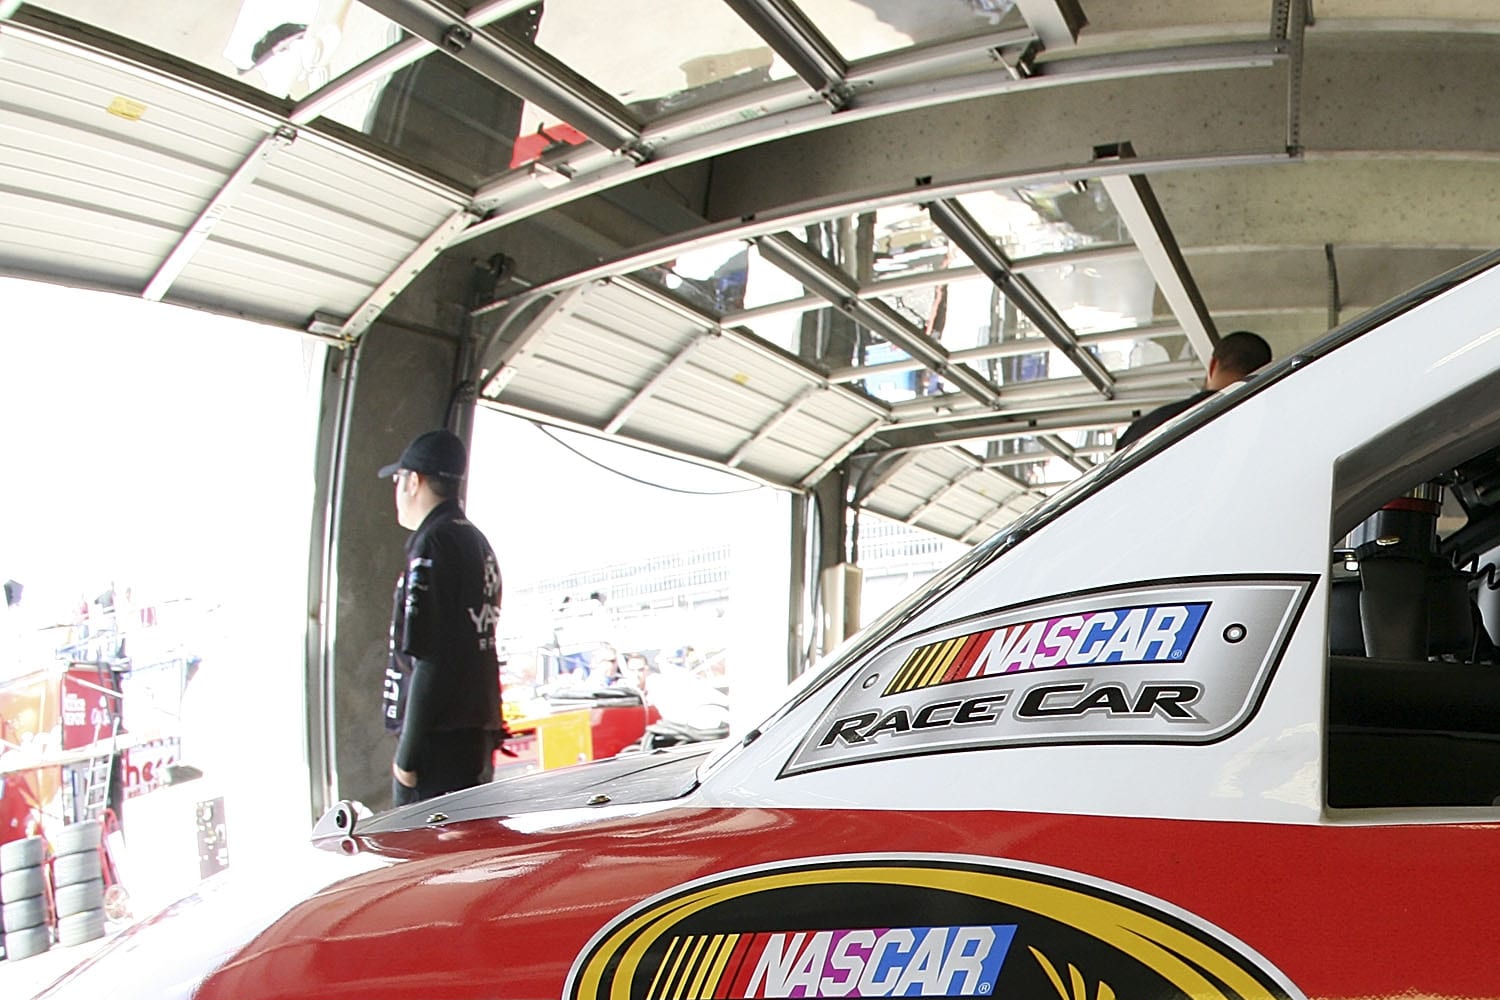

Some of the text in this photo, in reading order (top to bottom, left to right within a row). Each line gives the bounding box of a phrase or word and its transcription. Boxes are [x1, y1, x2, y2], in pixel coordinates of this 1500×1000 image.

[966, 605, 1187, 678] NASCAR
[818, 683, 1203, 747] RACE CAR
[743, 927, 995, 997] NASCAR
